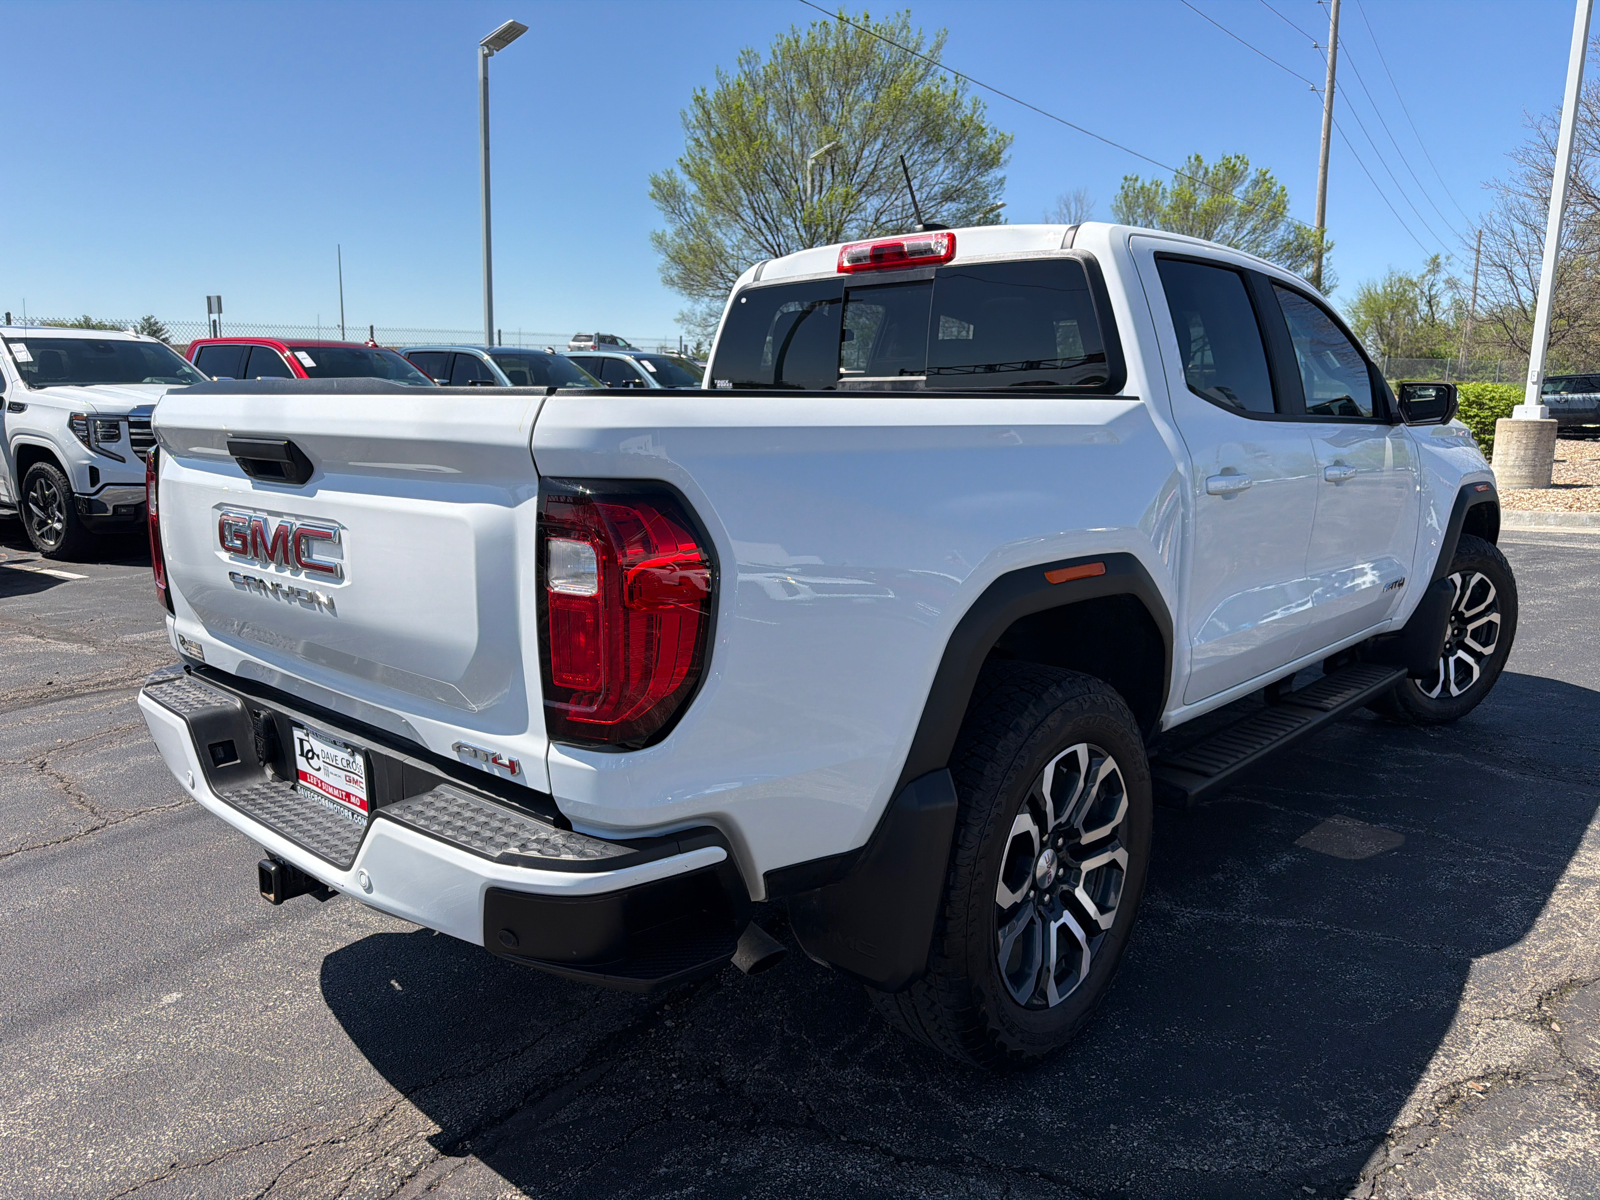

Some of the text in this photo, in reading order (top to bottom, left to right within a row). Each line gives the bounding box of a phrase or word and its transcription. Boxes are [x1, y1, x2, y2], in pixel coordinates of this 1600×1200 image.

[218, 509, 343, 579] GMC
[228, 571, 335, 609] CANYON
[321, 749, 363, 775] DAVE CROSS
[452, 740, 520, 777] AT4
[306, 773, 322, 787] LEE'S
[322, 782, 349, 802] SUMMIT,
[350, 795, 361, 806] MO
[345, 774, 364, 790] GMC
